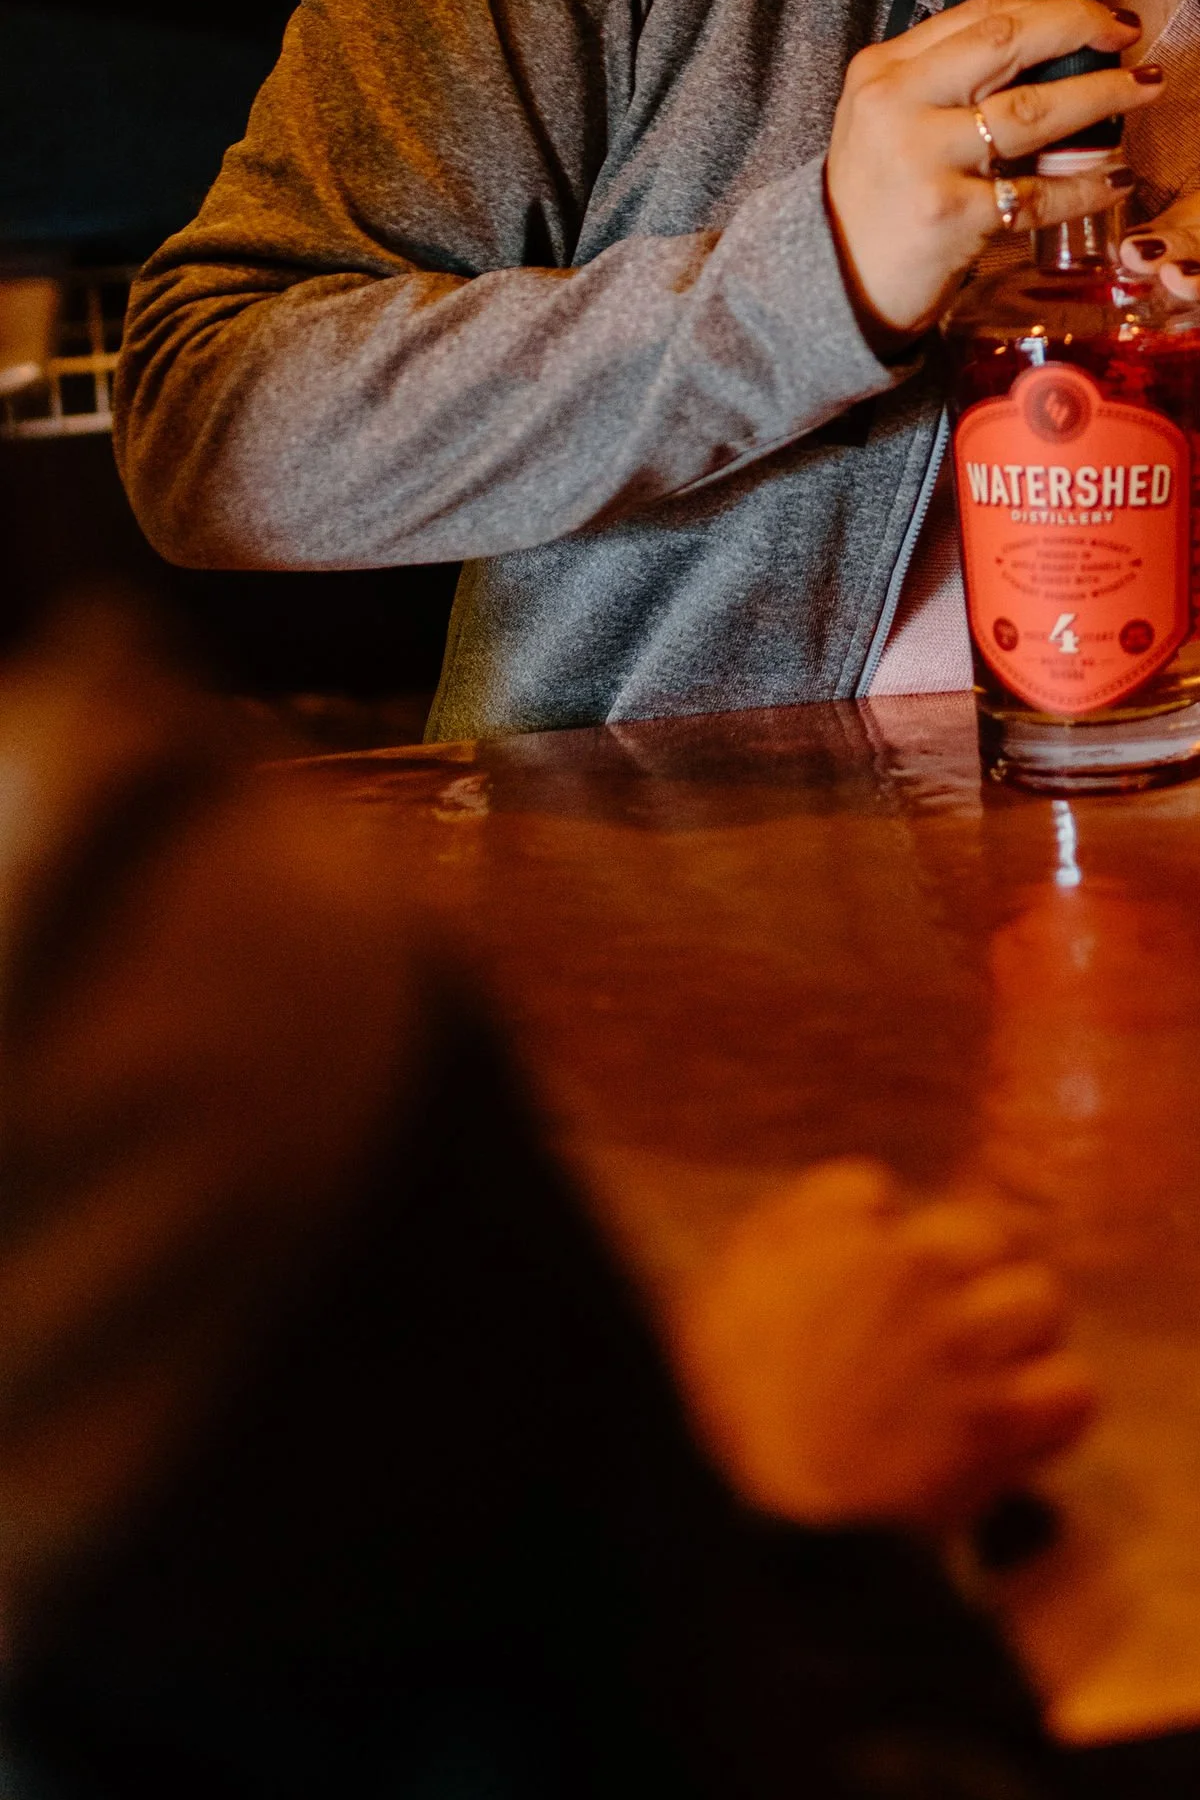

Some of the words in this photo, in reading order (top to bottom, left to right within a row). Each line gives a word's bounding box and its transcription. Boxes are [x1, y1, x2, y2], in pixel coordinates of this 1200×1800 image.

[966, 462, 1172, 507] WATERSHED
[1011, 509, 1114, 526] DISTILLERY
[1048, 613, 1080, 654] 4
